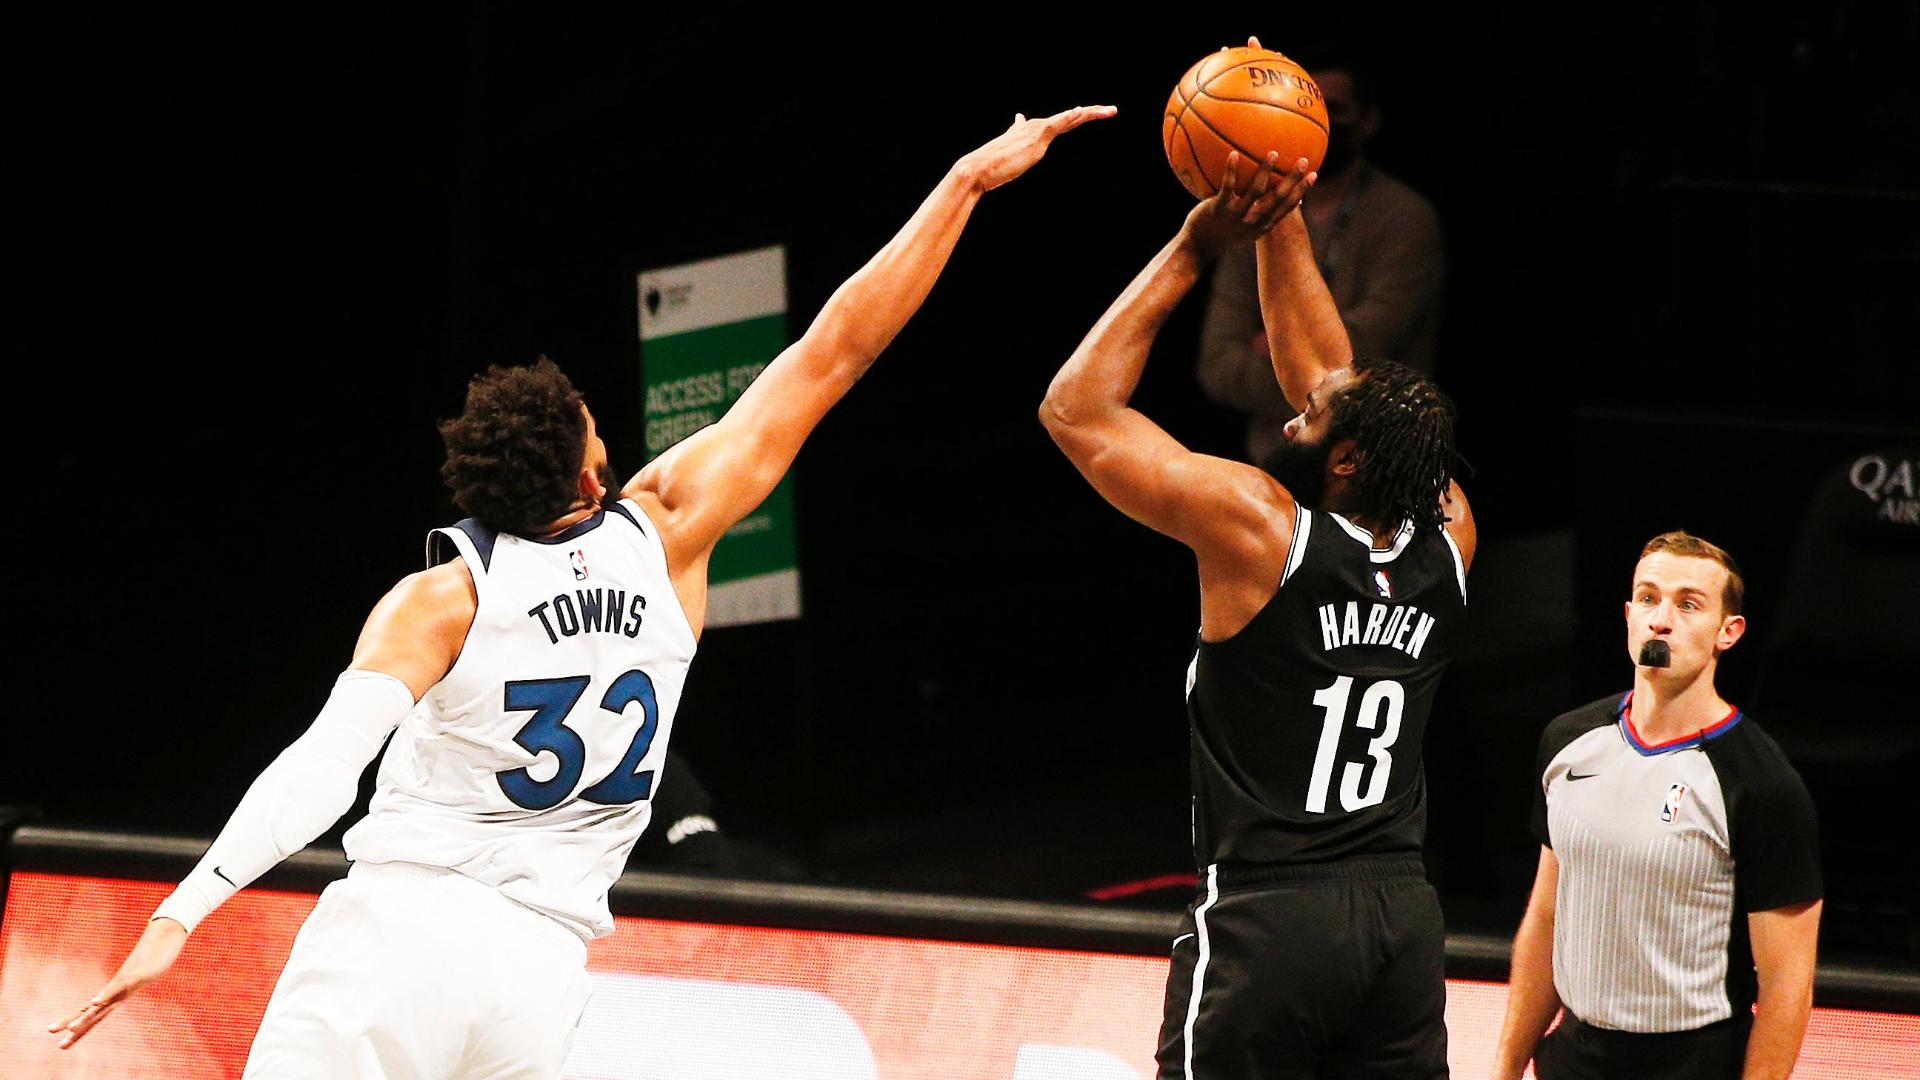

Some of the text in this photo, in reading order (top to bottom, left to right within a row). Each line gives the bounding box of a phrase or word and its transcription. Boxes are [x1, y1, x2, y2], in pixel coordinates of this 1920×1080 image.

[645, 370, 725, 415] ACCESS
[1849, 455, 1920, 500] QA
[1877, 498, 1920, 525] AIR
[528, 588, 646, 644] TOWNS
[1318, 601, 1436, 660] HARDEN
[495, 669, 659, 811] 32
[1305, 675, 1405, 814] 13
